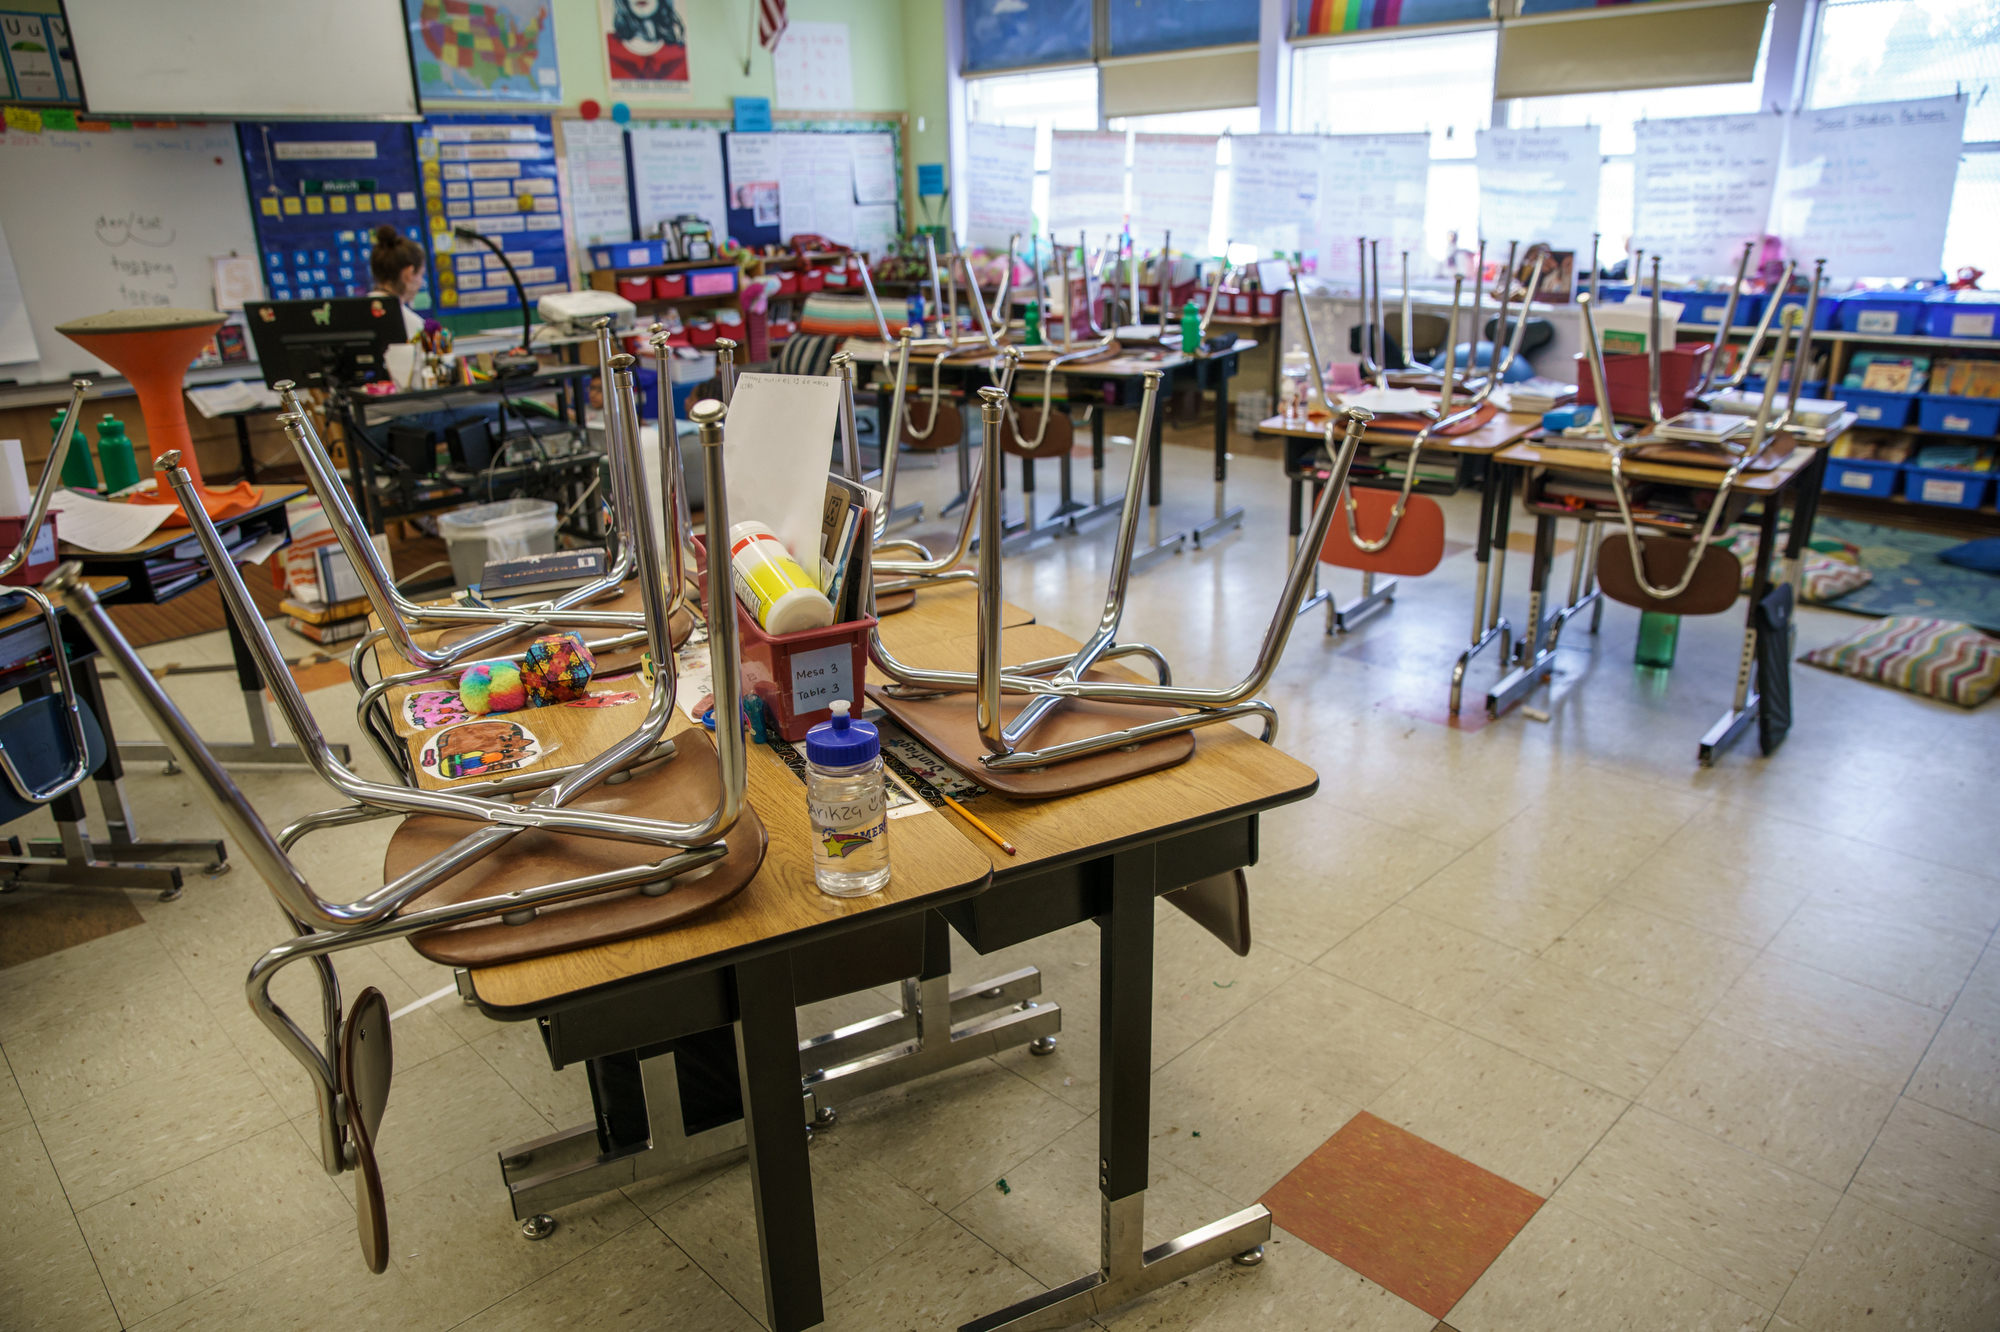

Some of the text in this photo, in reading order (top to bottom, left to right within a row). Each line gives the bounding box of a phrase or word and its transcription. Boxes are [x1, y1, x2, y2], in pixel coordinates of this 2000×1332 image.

[6, 18, 20, 35] U
[323, 180, 358, 192] March
[271, 254, 280, 266] 5
[297, 253, 306, 265] 6
[318, 251, 326, 263] 7
[796, 663, 838, 680] Mesa 3
[797, 683, 840, 701] Table 3
[806, 796, 863, 821] Arikza
